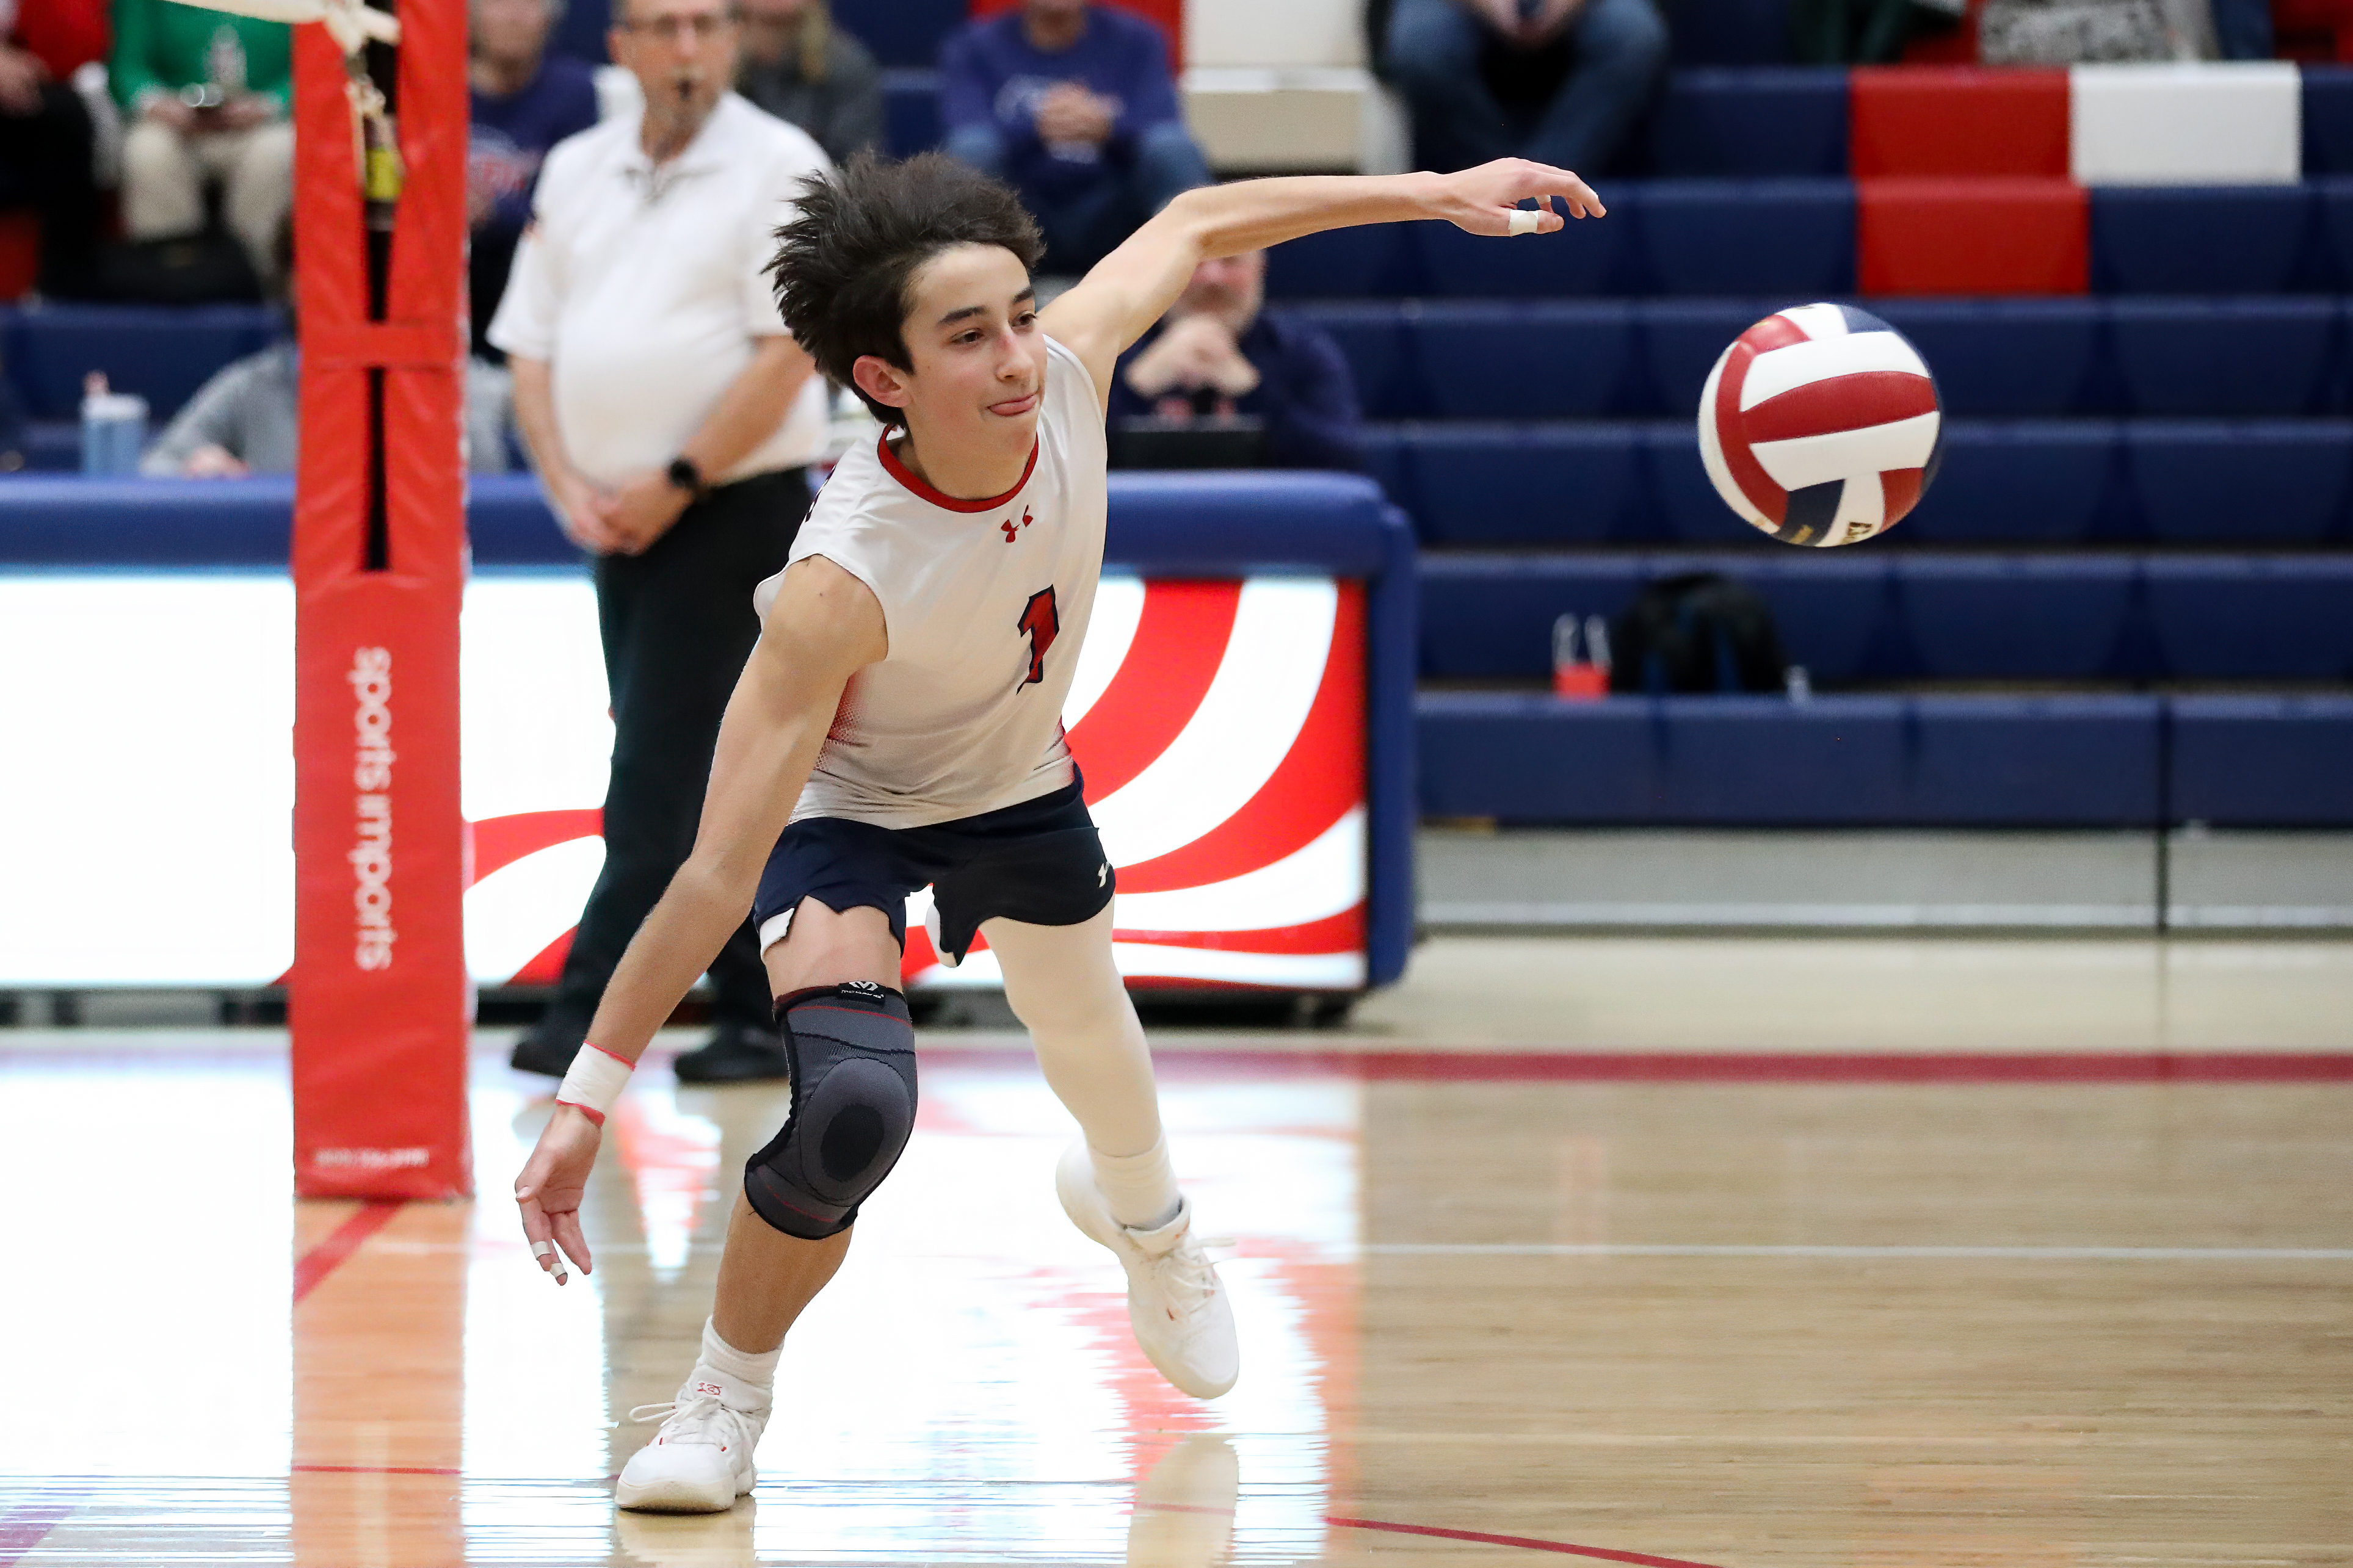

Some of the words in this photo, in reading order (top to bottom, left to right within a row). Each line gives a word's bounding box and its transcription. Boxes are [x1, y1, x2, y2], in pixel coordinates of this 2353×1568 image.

[1017, 584, 1060, 695] 1
[348, 647, 396, 791] sports
[348, 794, 397, 970] imports
